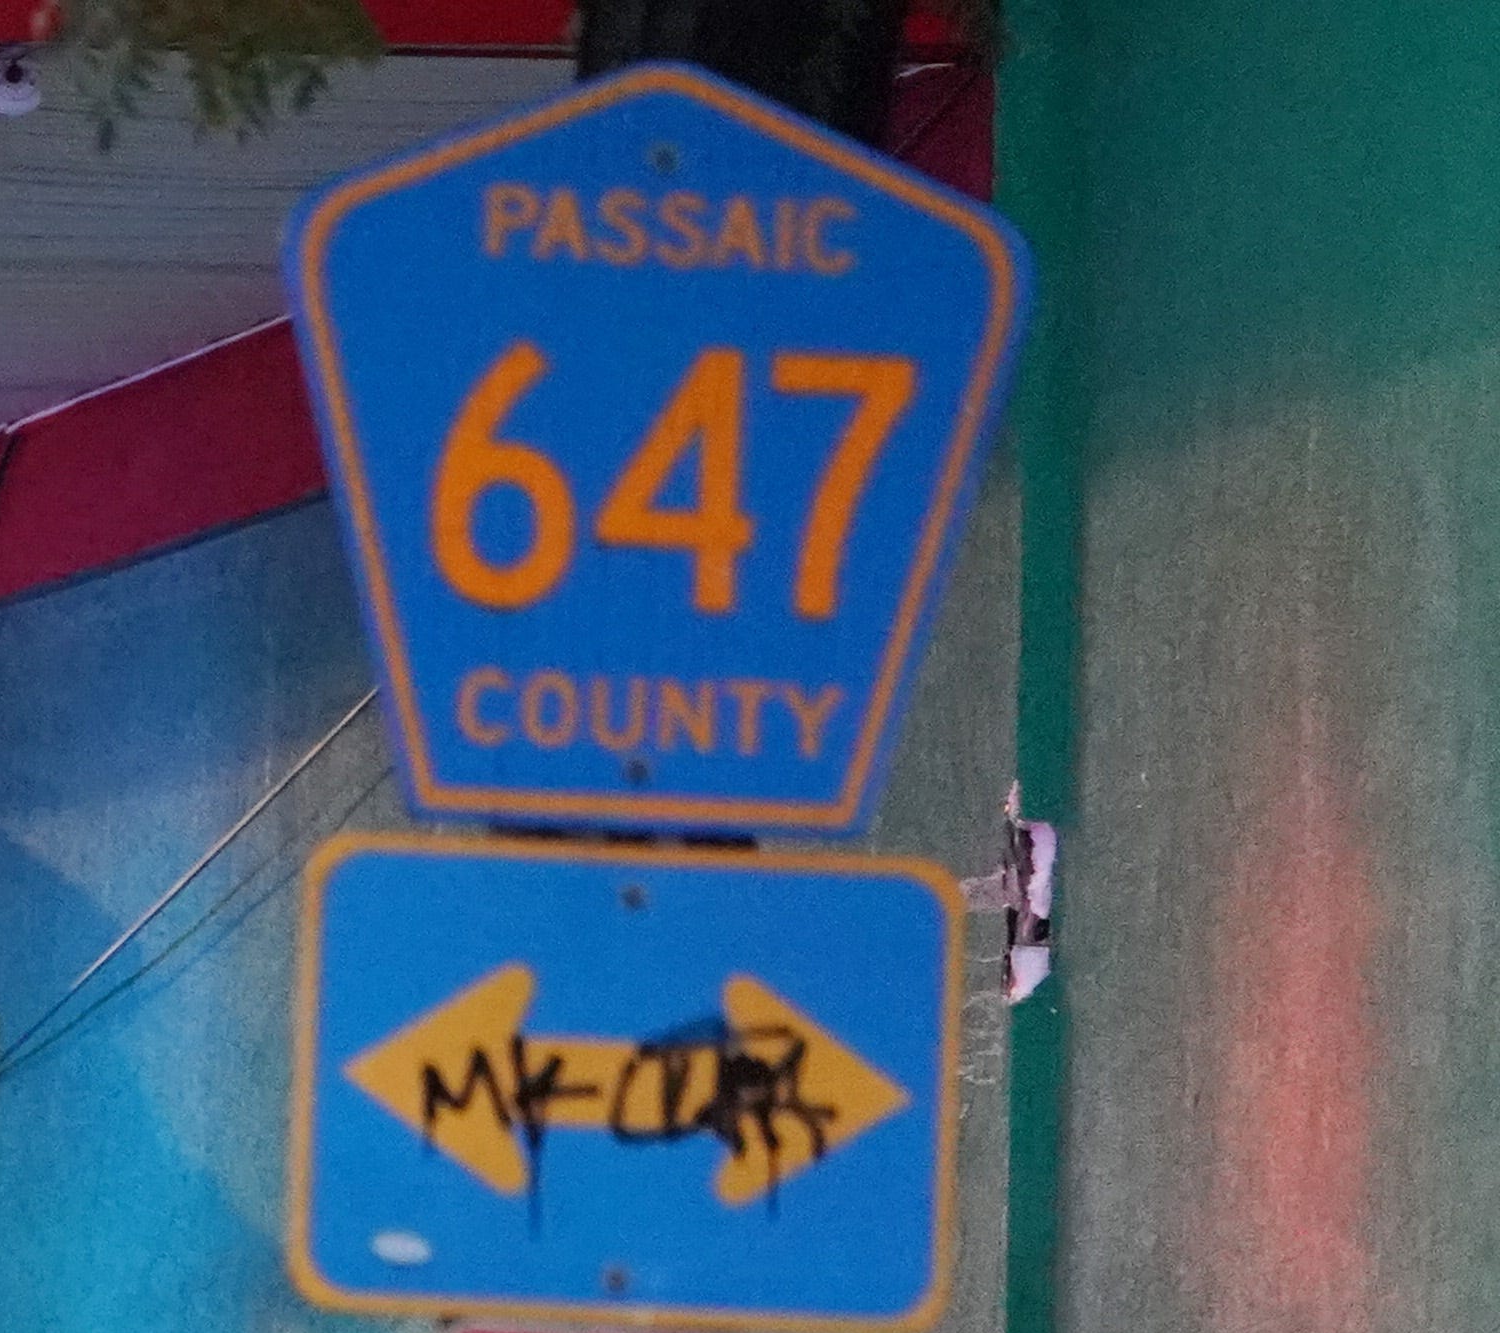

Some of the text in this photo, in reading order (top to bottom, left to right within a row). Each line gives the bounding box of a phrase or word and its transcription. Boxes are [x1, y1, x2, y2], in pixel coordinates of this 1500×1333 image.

[481, 183, 857, 275] PASSAIC
[428, 340, 918, 621] 647
[456, 667, 843, 760] COUNTY
